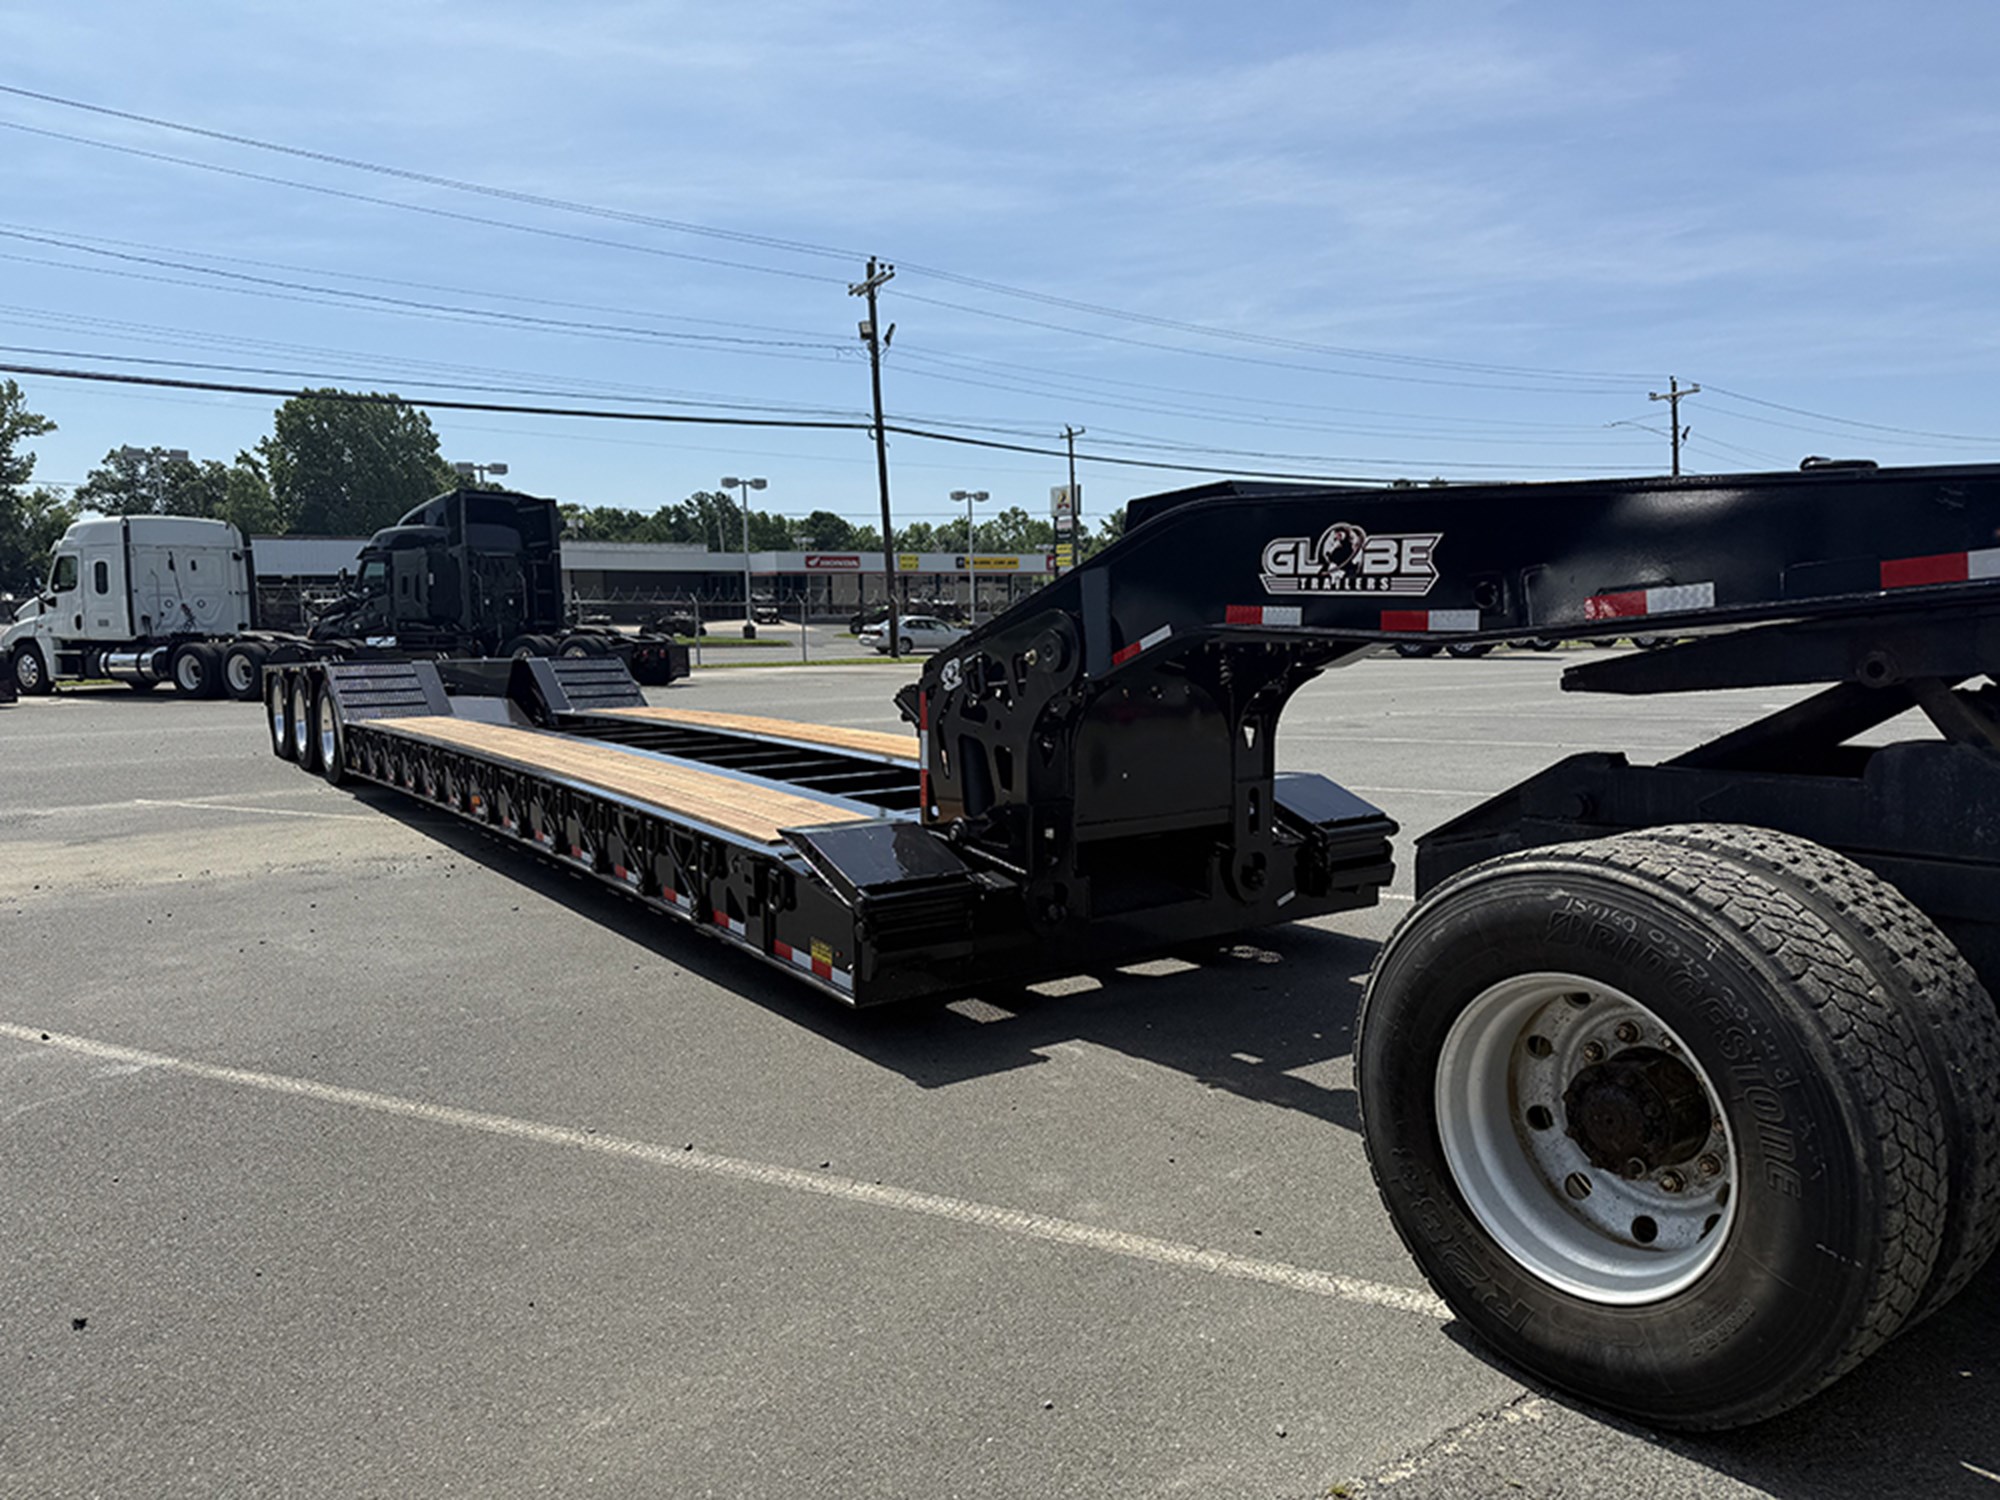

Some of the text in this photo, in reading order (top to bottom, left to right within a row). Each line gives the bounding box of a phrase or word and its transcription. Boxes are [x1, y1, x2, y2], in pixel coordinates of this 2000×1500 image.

[820, 559, 859, 567] HONDA
[1264, 523, 1435, 577] GLOBE
[1300, 577, 1390, 591] TRAILERS
[1543, 908, 1801, 1198] BRIDGESTONE
